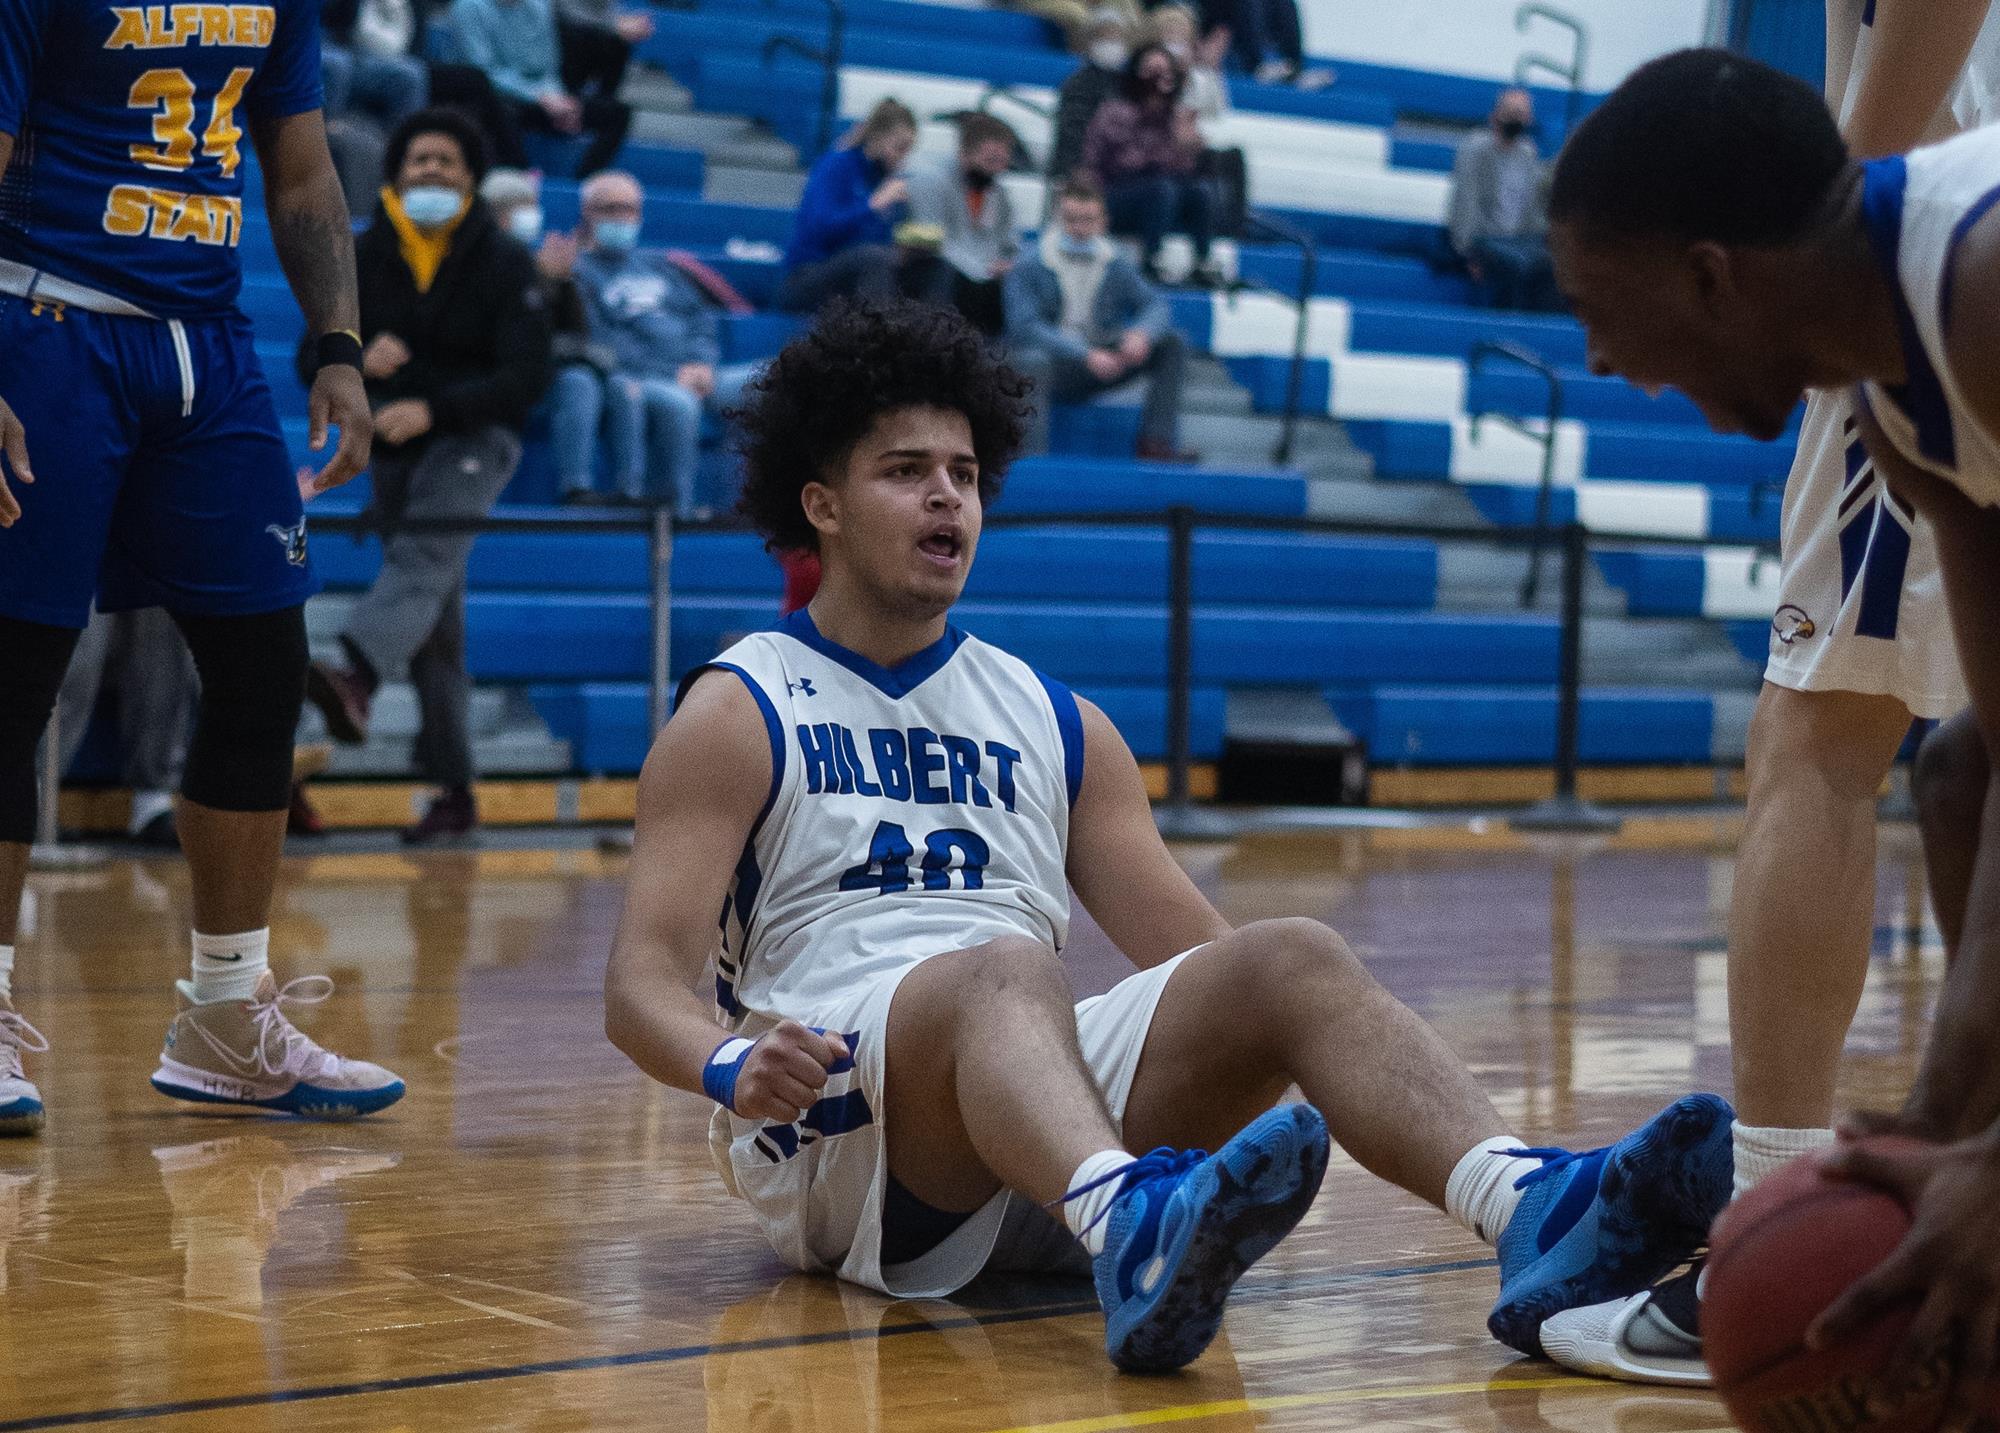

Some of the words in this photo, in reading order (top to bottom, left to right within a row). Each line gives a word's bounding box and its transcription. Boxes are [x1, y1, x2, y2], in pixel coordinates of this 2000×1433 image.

[103, 3, 276, 49] ALFRED
[126, 66, 254, 179] 34
[796, 721, 1022, 815] HILBERT
[838, 818, 990, 896] 40
